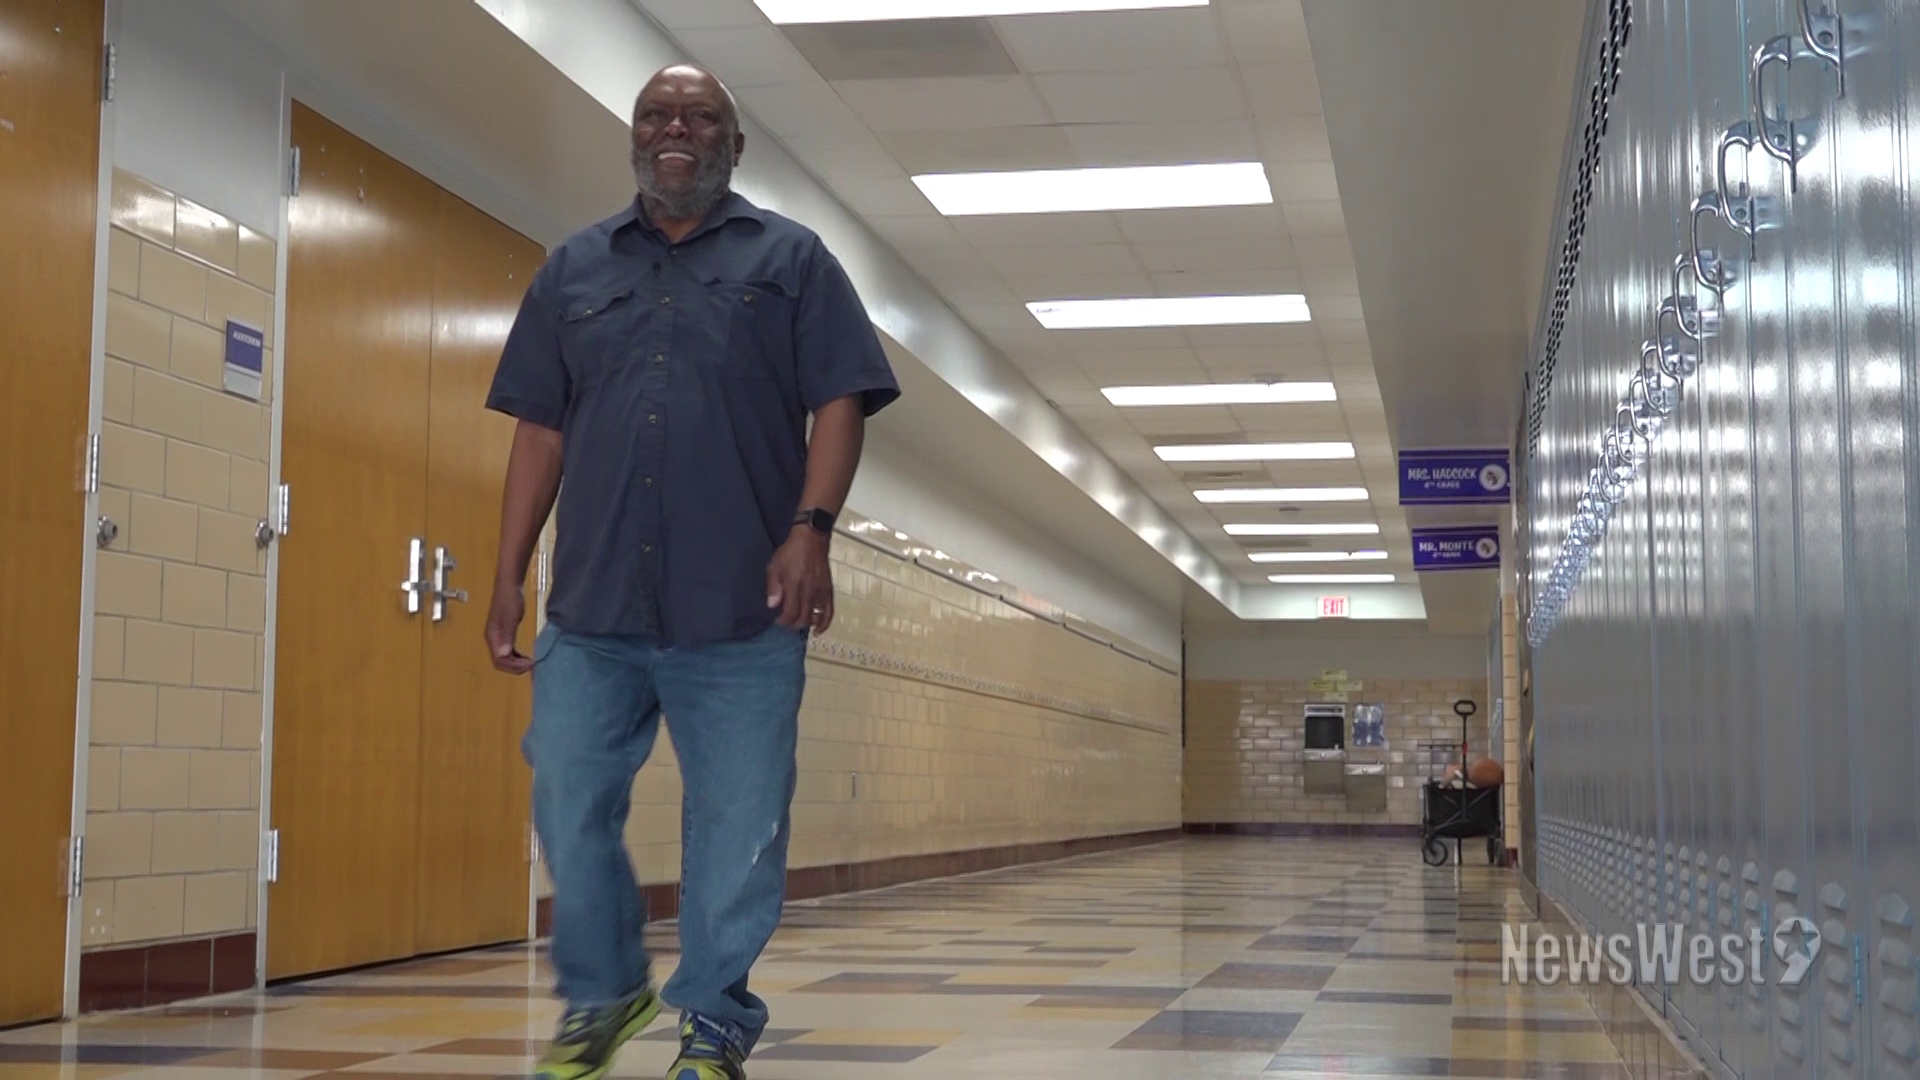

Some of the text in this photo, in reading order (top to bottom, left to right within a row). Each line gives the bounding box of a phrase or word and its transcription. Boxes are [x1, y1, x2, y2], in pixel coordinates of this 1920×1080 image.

[1408, 467, 1431, 480] MRS.
[1419, 541, 1474, 552] MR. MONTE
[1323, 597, 1344, 615] EXIT
